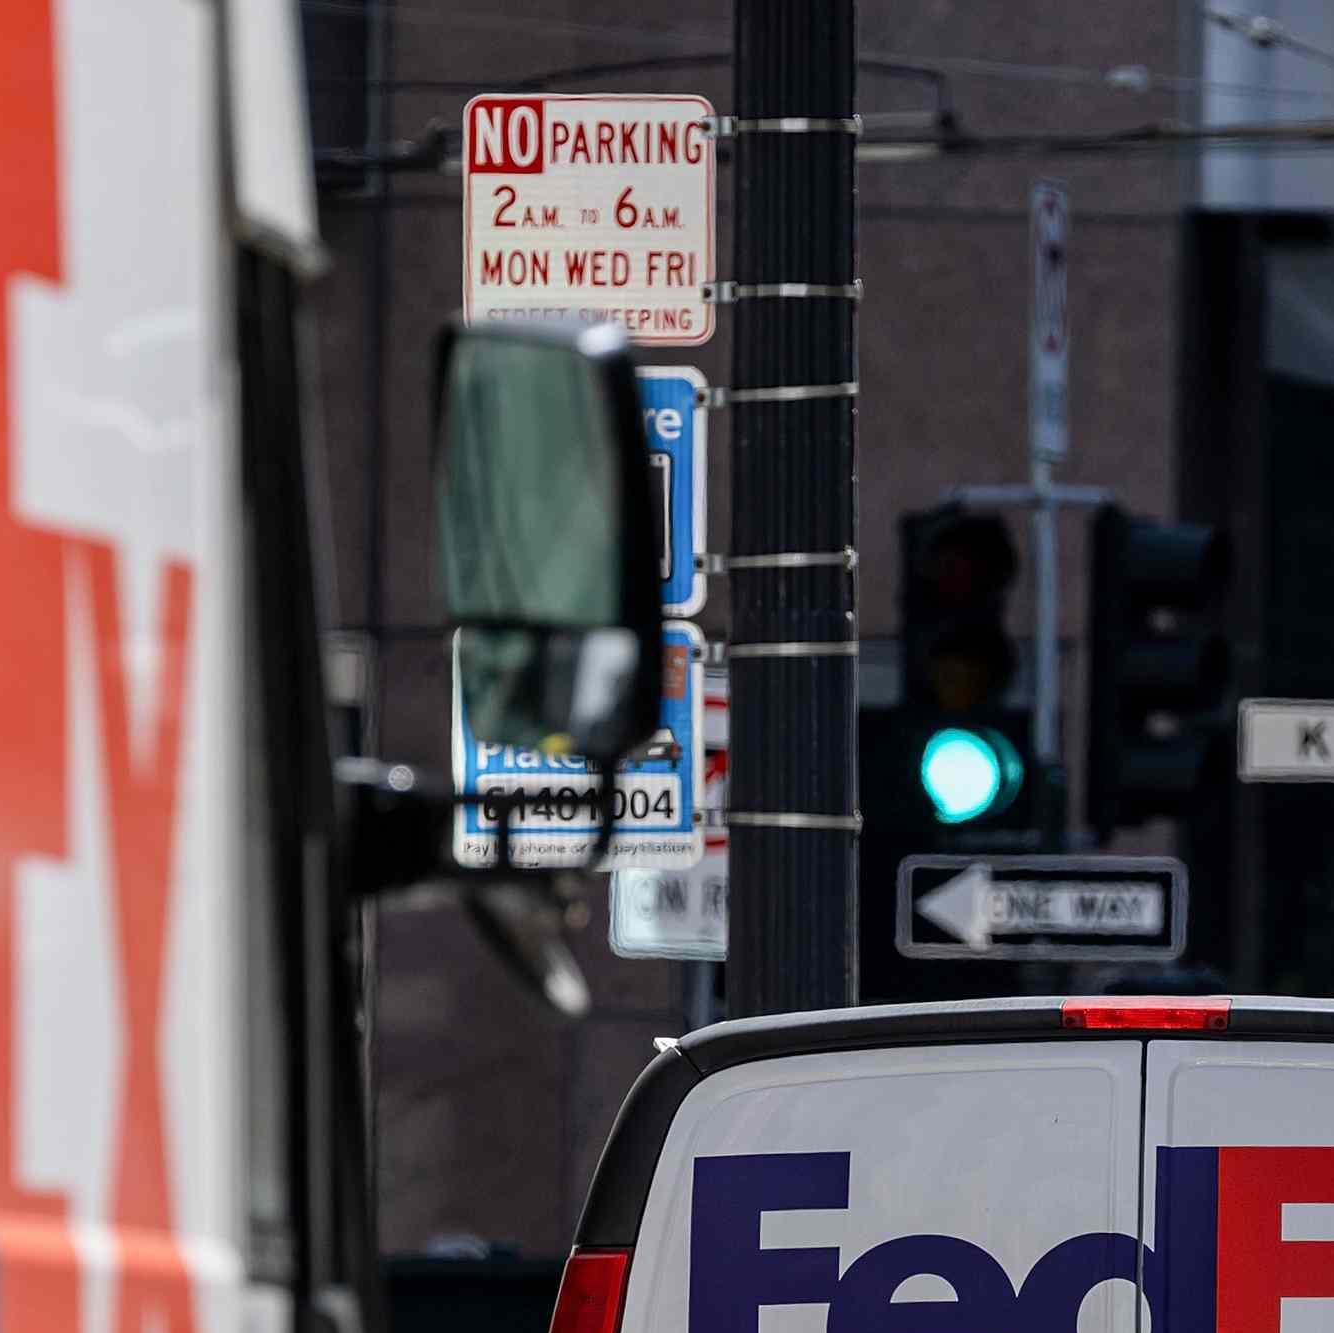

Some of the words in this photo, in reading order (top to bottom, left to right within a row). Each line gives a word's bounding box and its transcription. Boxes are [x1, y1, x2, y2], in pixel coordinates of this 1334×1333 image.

[474, 105, 541, 168] NO
[550, 120, 702, 165] PARKING
[481, 249, 550, 286] MON
[565, 250, 631, 286] WED
[645, 250, 696, 286] FRI
